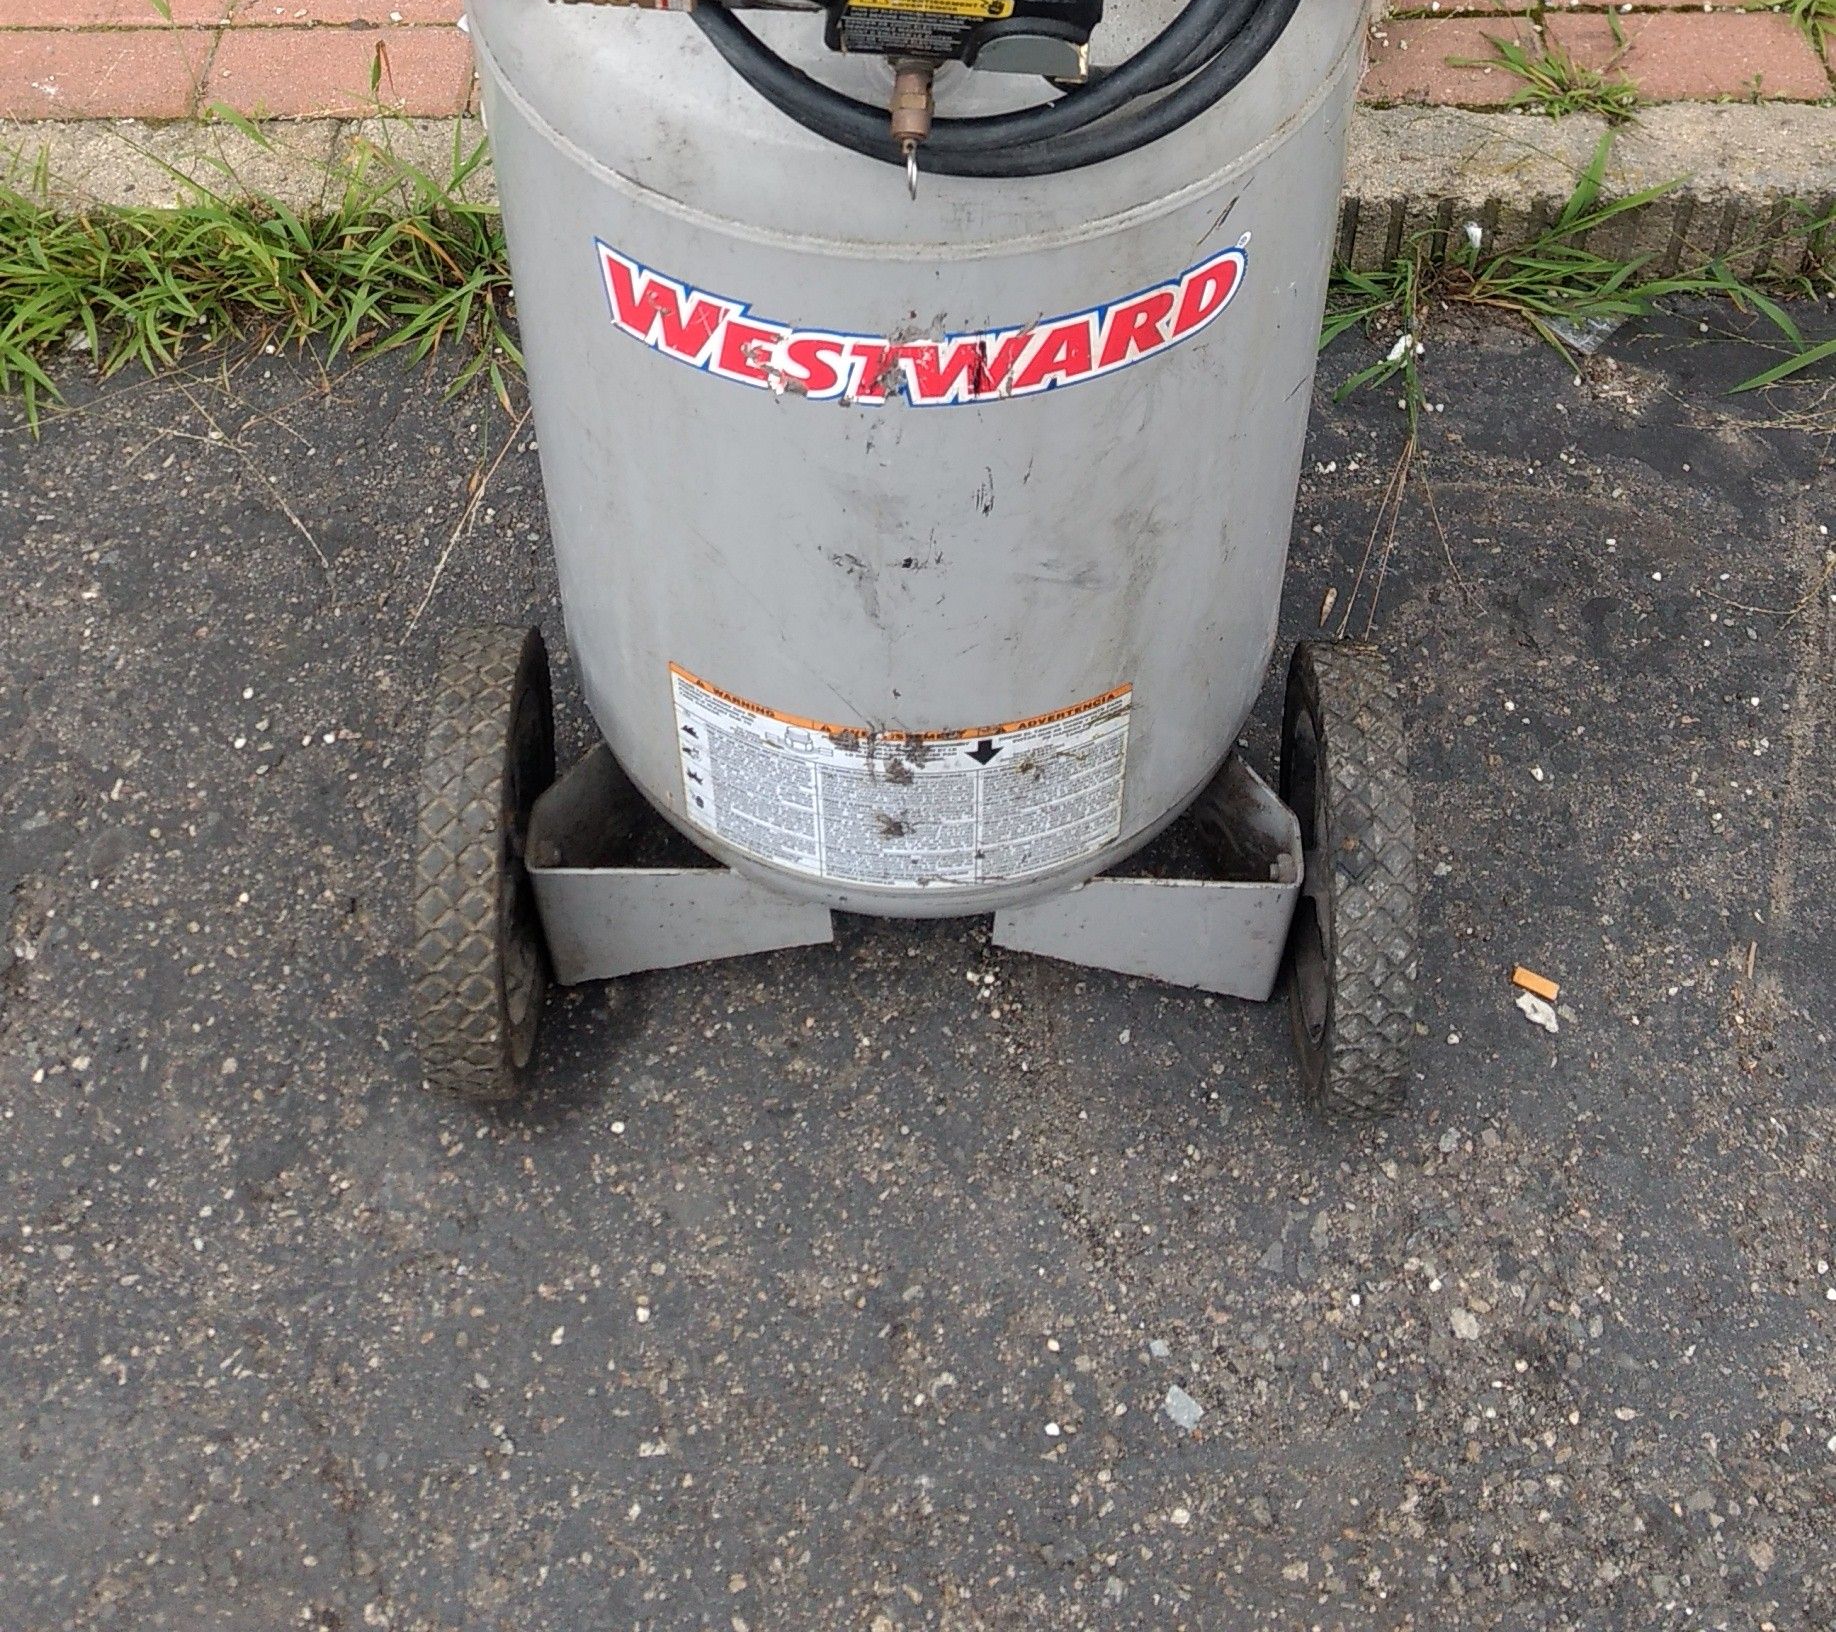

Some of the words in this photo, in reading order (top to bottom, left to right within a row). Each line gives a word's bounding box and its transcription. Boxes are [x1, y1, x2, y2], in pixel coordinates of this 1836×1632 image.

[598, 243, 1246, 404] WESTWARD
[712, 687, 775, 719] WARNING
[1018, 692, 1116, 730] ADVERTENCIA
